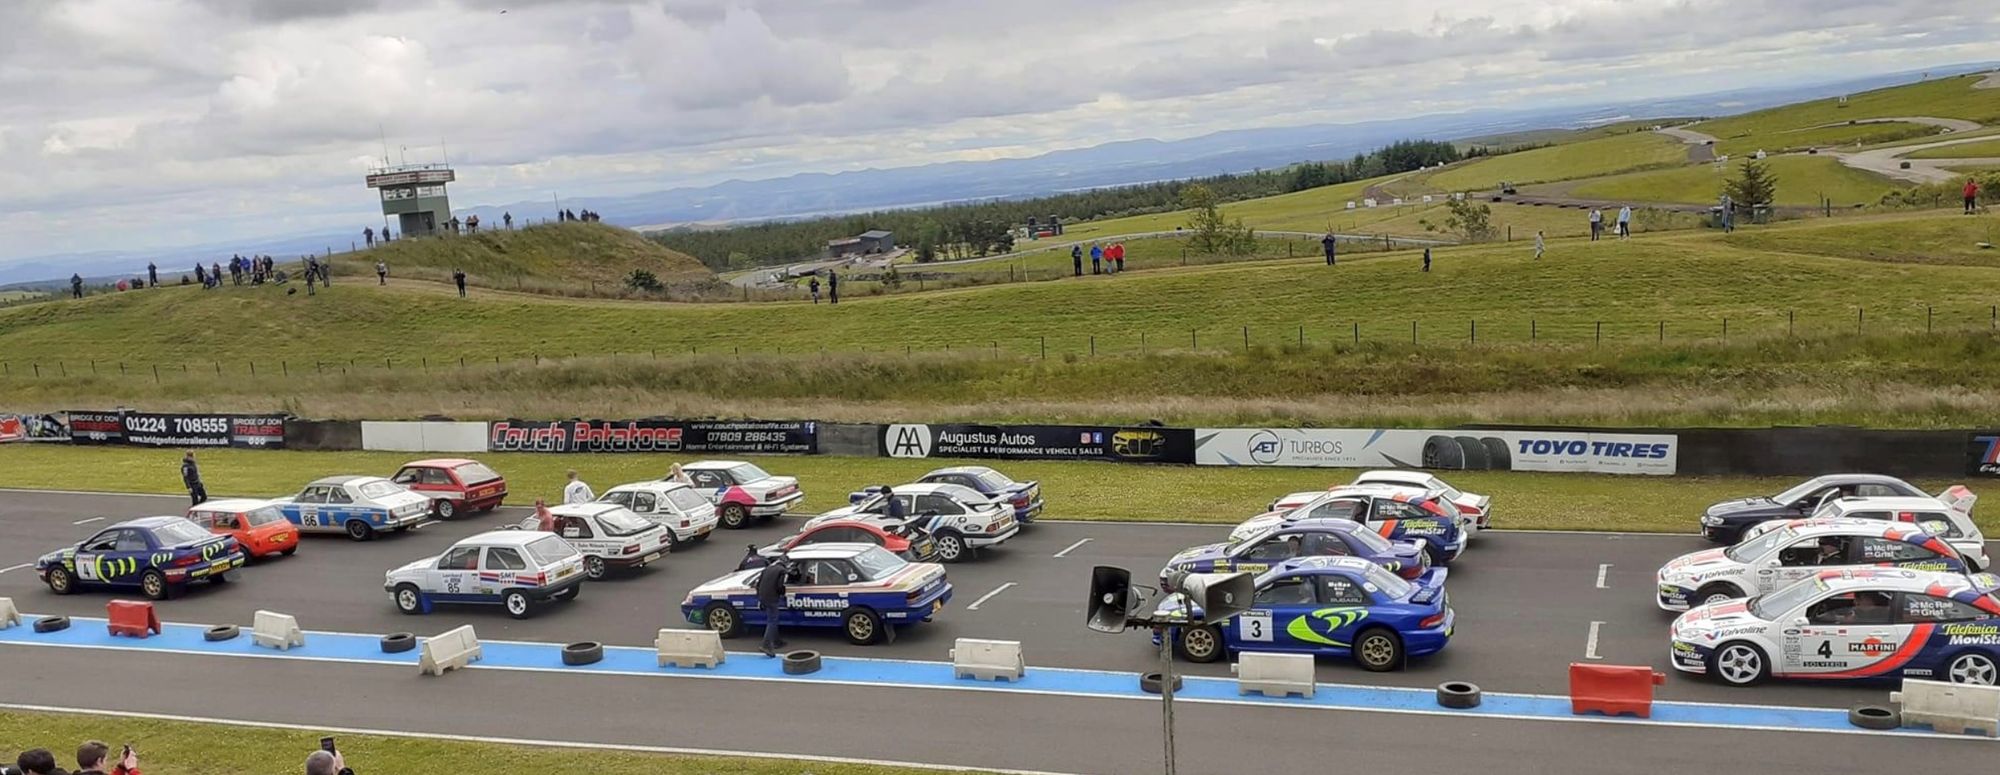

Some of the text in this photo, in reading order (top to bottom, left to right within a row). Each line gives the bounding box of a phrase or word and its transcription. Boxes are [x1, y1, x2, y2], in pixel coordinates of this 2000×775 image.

[126, 416, 228, 433] 01224 708555
[492, 422, 683, 451] Couch Potatoes
[707, 432, 786, 442] 07809 286435
[939, 430, 1035, 446] Augustus Autos
[1290, 440, 1343, 454] TURBOS
[1518, 439, 1669, 459] TOYO TIRES
[302, 515, 318, 527] 86
[1704, 568, 1746, 579] Valvoline
[447, 582, 460, 593] 85
[786, 597, 849, 609] Rothmans
[1920, 601, 1934, 609] Mc
[1251, 620, 1262, 638] 3
[1720, 625, 1767, 638] Valvoline
[1817, 640, 1833, 659] 4
[1850, 643, 1896, 652] MARTINI
